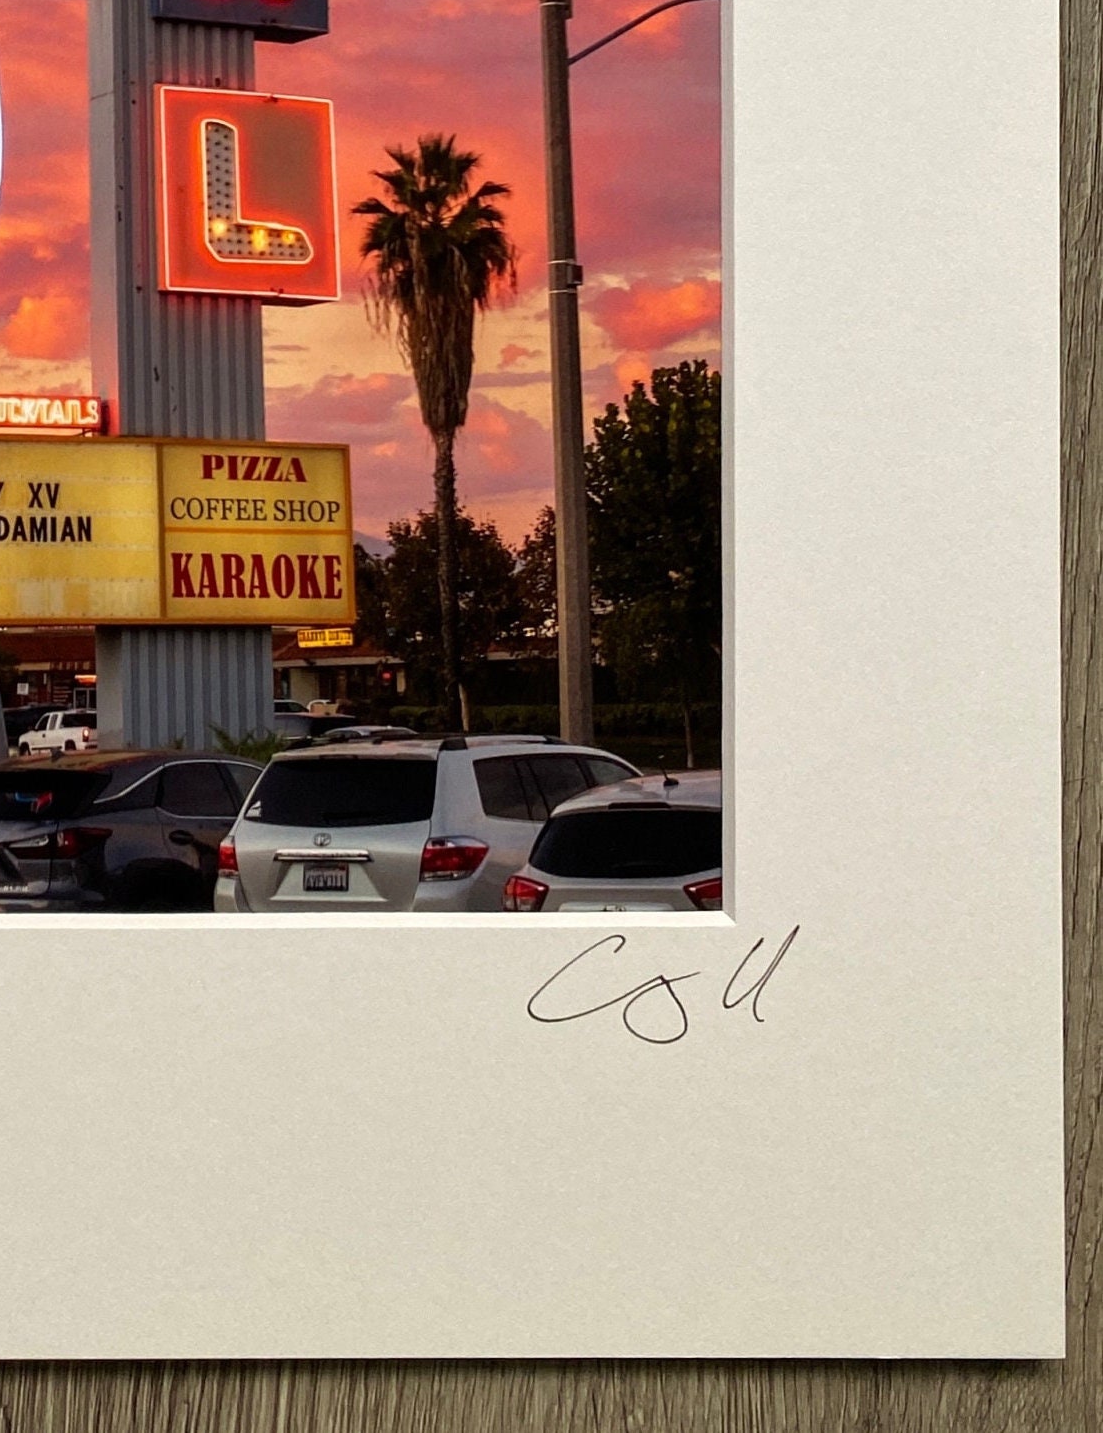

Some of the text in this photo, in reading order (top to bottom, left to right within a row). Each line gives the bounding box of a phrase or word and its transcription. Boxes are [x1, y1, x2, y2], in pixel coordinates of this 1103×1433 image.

[201, 454, 308, 483] PIZZA
[28, 482, 60, 509] XV
[170, 497, 340, 523] COFFEE SHOP
[170, 552, 343, 600] KARAOKE
